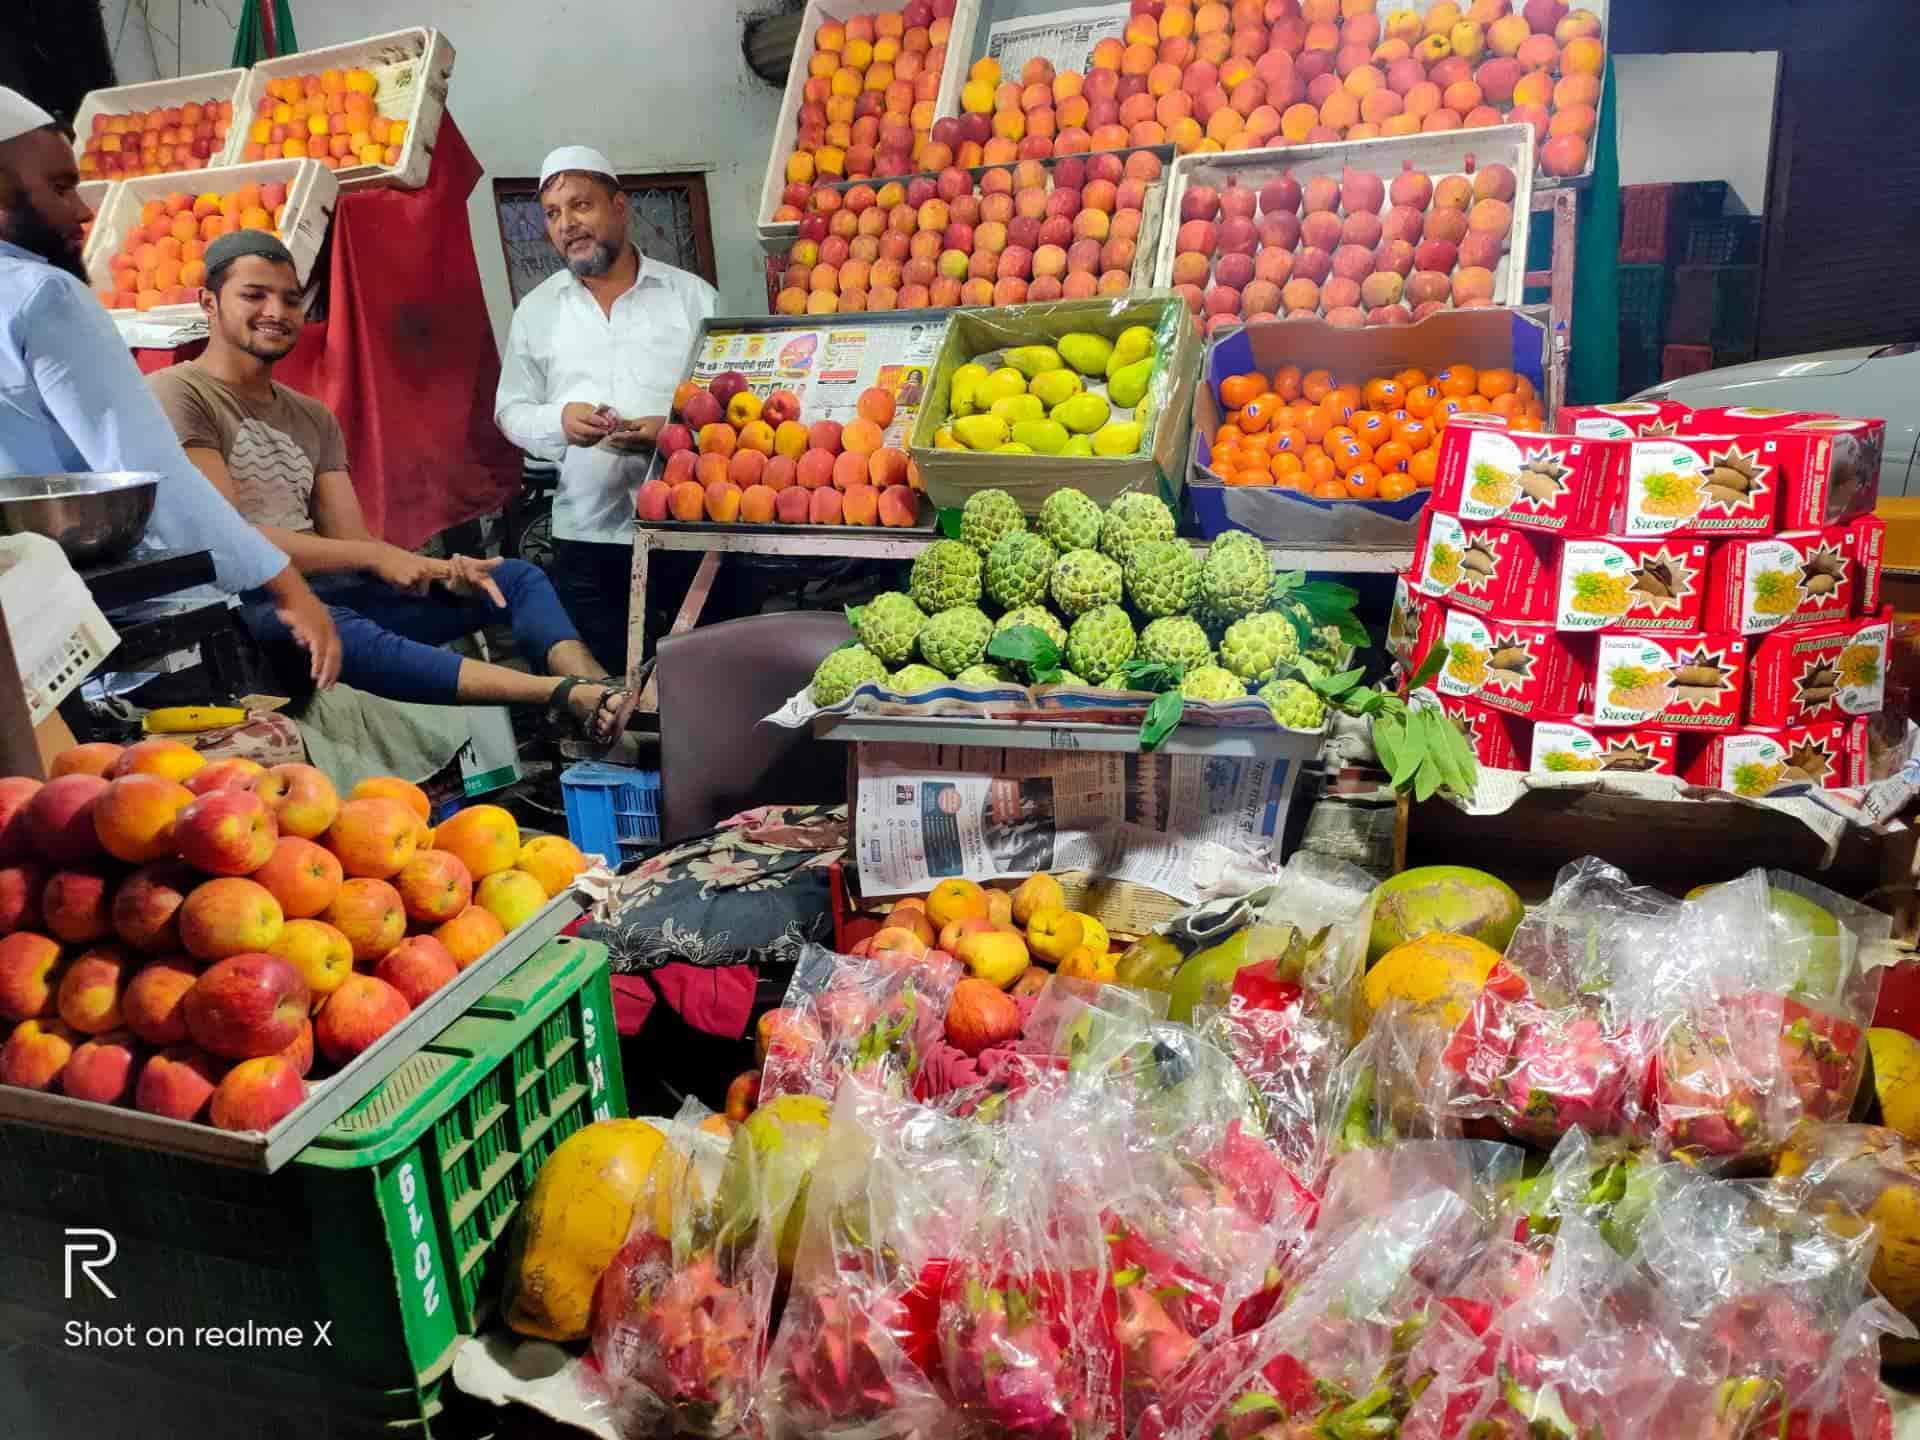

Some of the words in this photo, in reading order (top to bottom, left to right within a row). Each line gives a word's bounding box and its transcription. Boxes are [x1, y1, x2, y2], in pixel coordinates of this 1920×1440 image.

[1462, 501, 1497, 516] Sweet
[1632, 515, 1679, 529] Sweet
[1686, 515, 1770, 530] Tamarind
[1562, 613, 1607, 627] Sweet
[1615, 616, 1696, 629] Tamarind
[1747, 615, 1783, 629] Sweet
[1440, 677, 1471, 693] Sweet
[1600, 707, 1648, 721] Sweet
[1652, 711, 1736, 726] Tamarind
